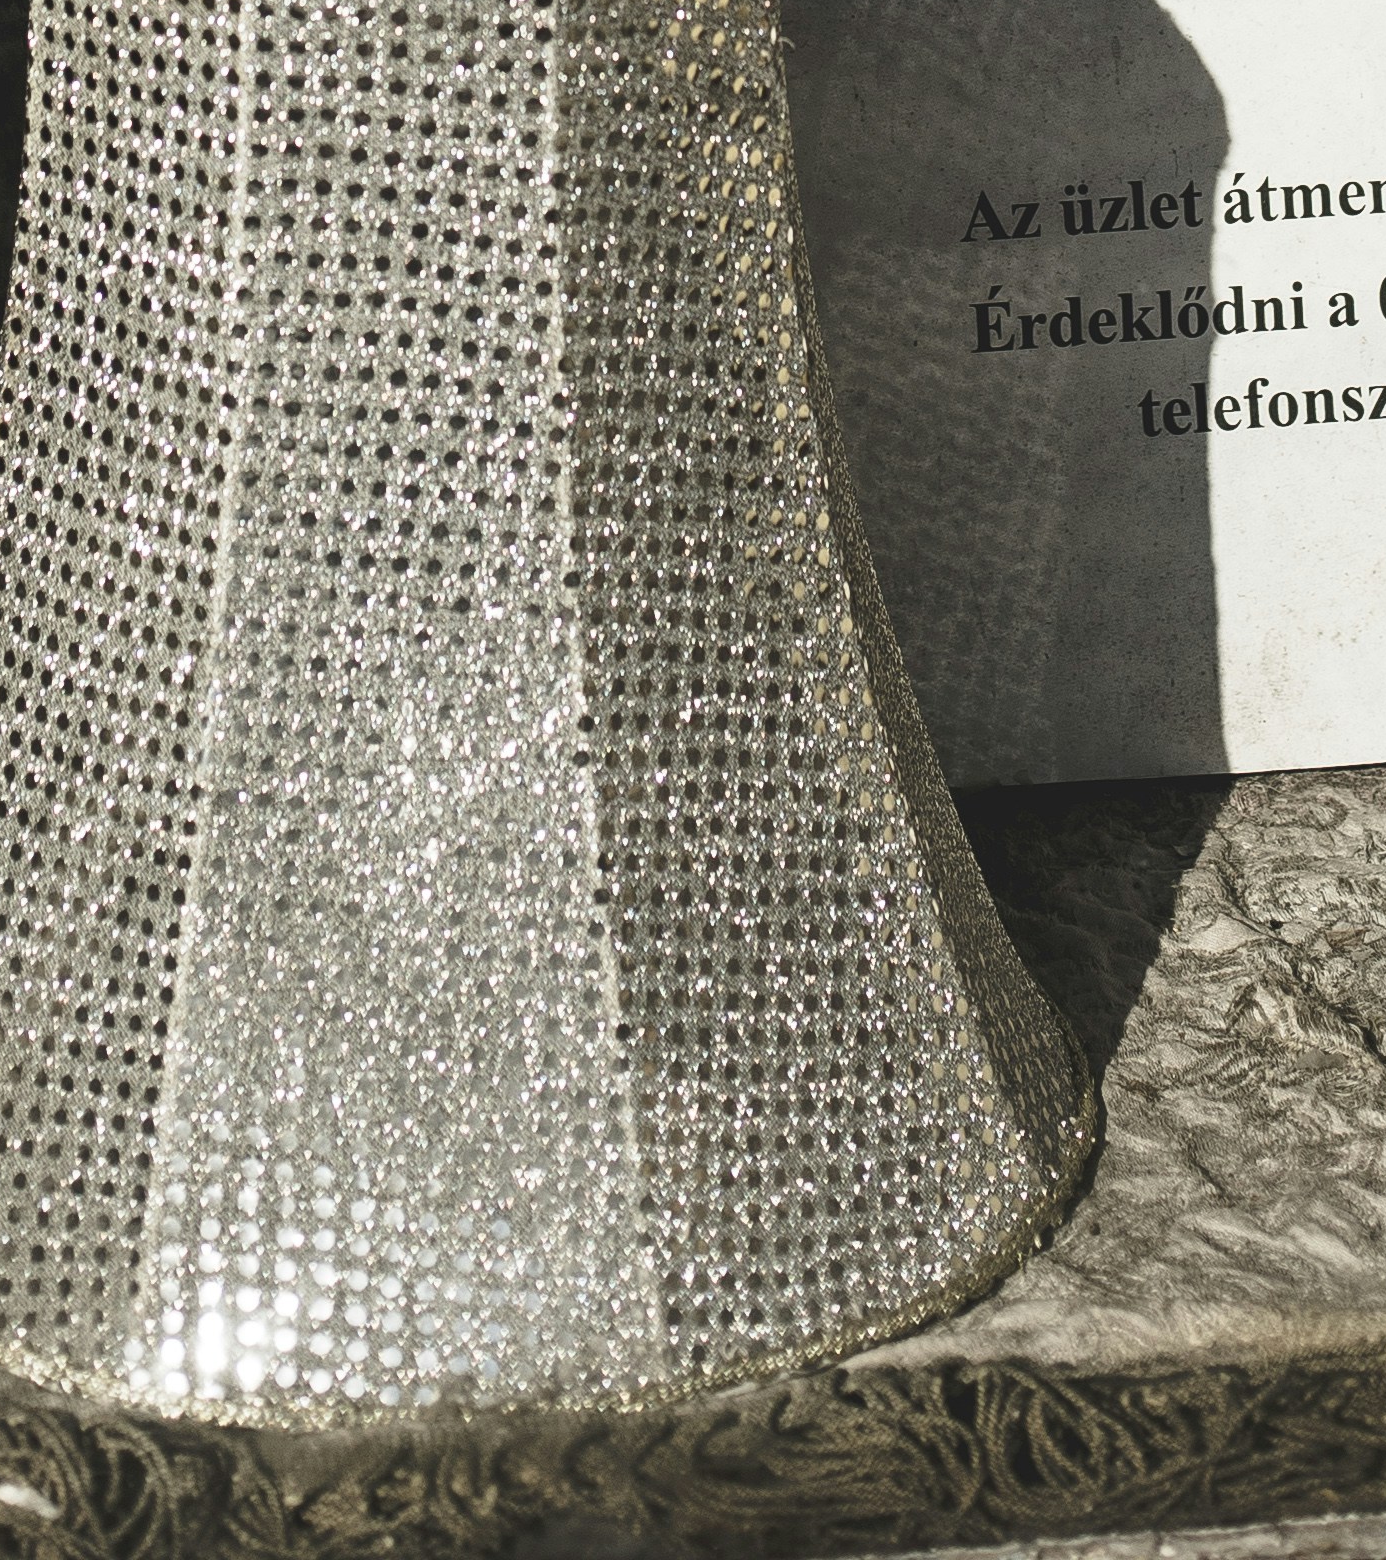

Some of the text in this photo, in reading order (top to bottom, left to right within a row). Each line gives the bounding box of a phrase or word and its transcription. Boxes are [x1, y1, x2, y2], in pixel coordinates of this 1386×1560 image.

[960, 191, 1041, 243] Az
[1059, 180, 1204, 235] üzlet
[970, 281, 1306, 354] Érdeklődni
[1328, 292, 1359, 328] a
